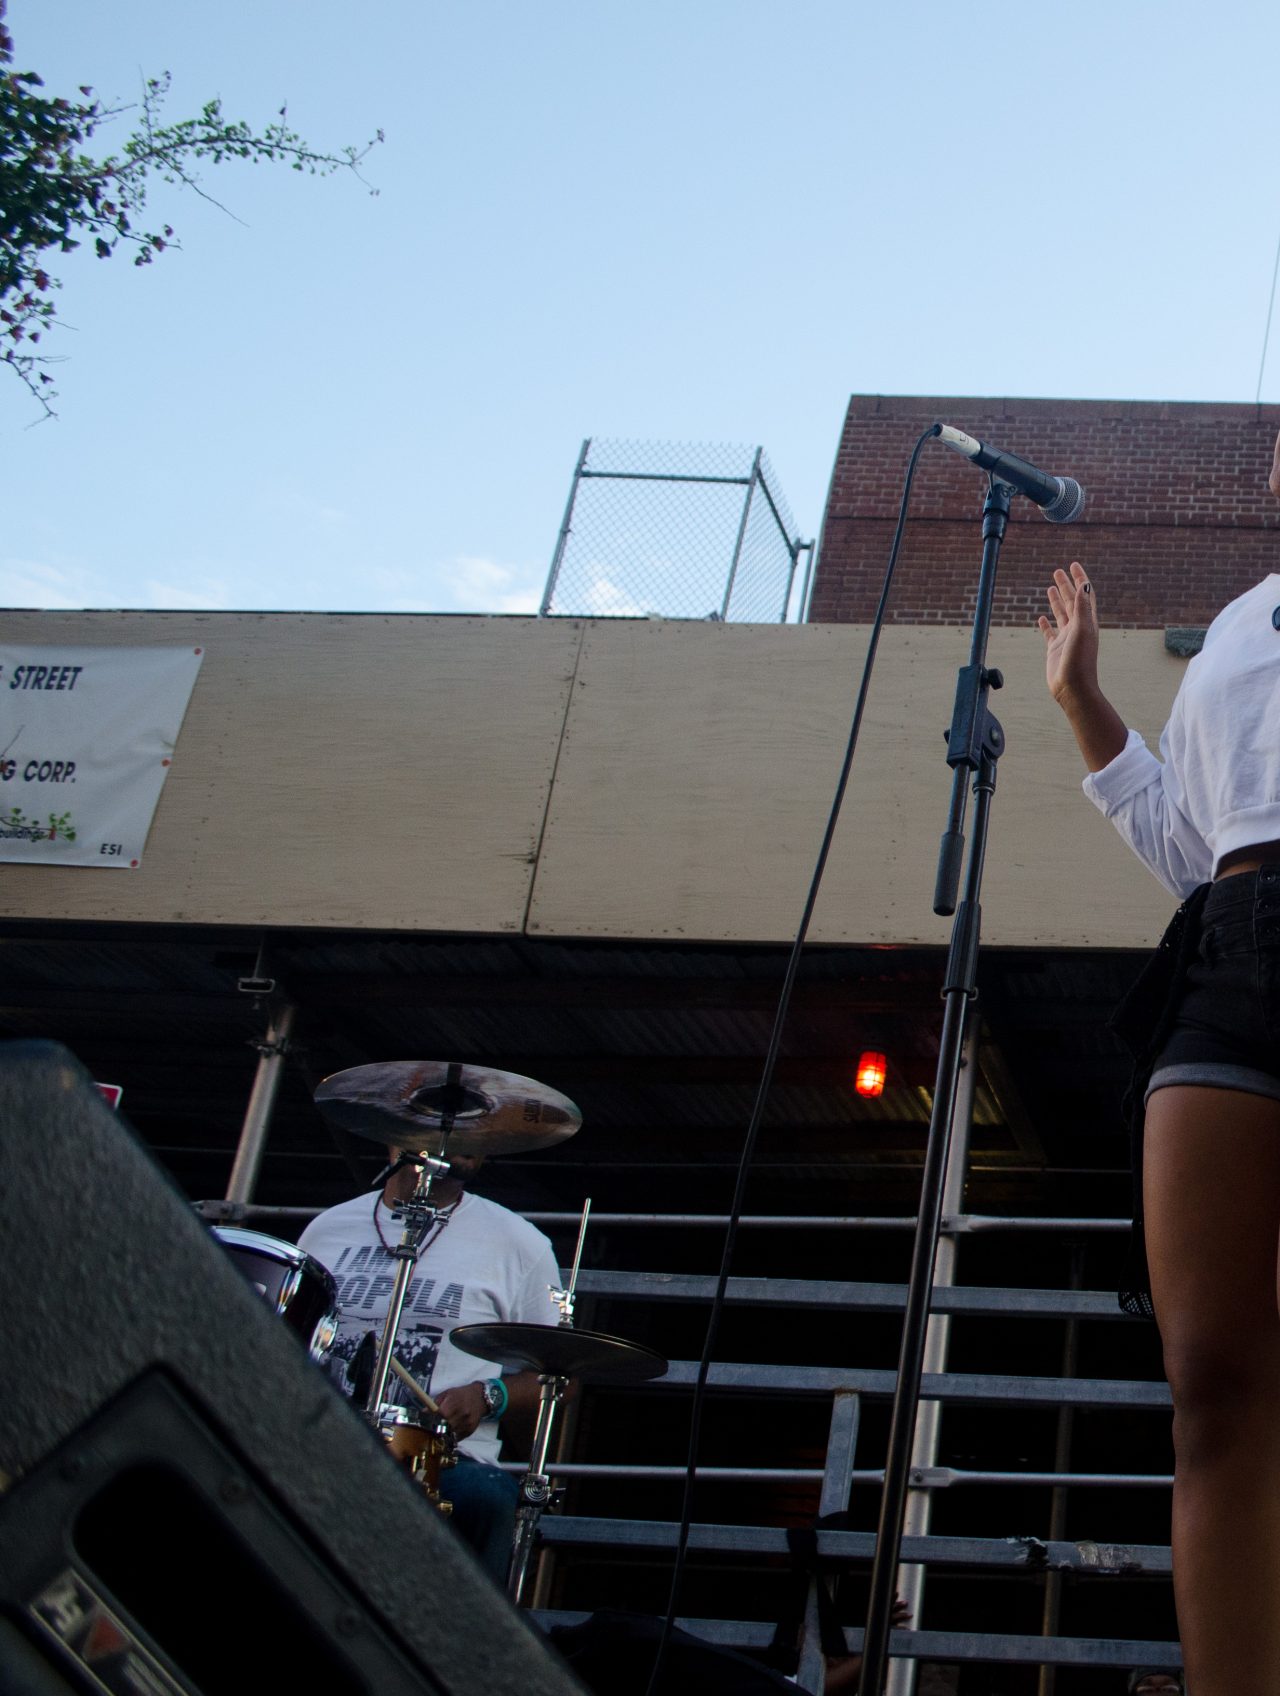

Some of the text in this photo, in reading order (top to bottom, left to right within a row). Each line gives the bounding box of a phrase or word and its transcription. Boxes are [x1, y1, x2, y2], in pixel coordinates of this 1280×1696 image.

[10, 665, 83, 691] STREET
[24, 760, 77, 783] CORP.
[100, 843, 122, 856] ESI
[333, 1246, 397, 1273] I AM
